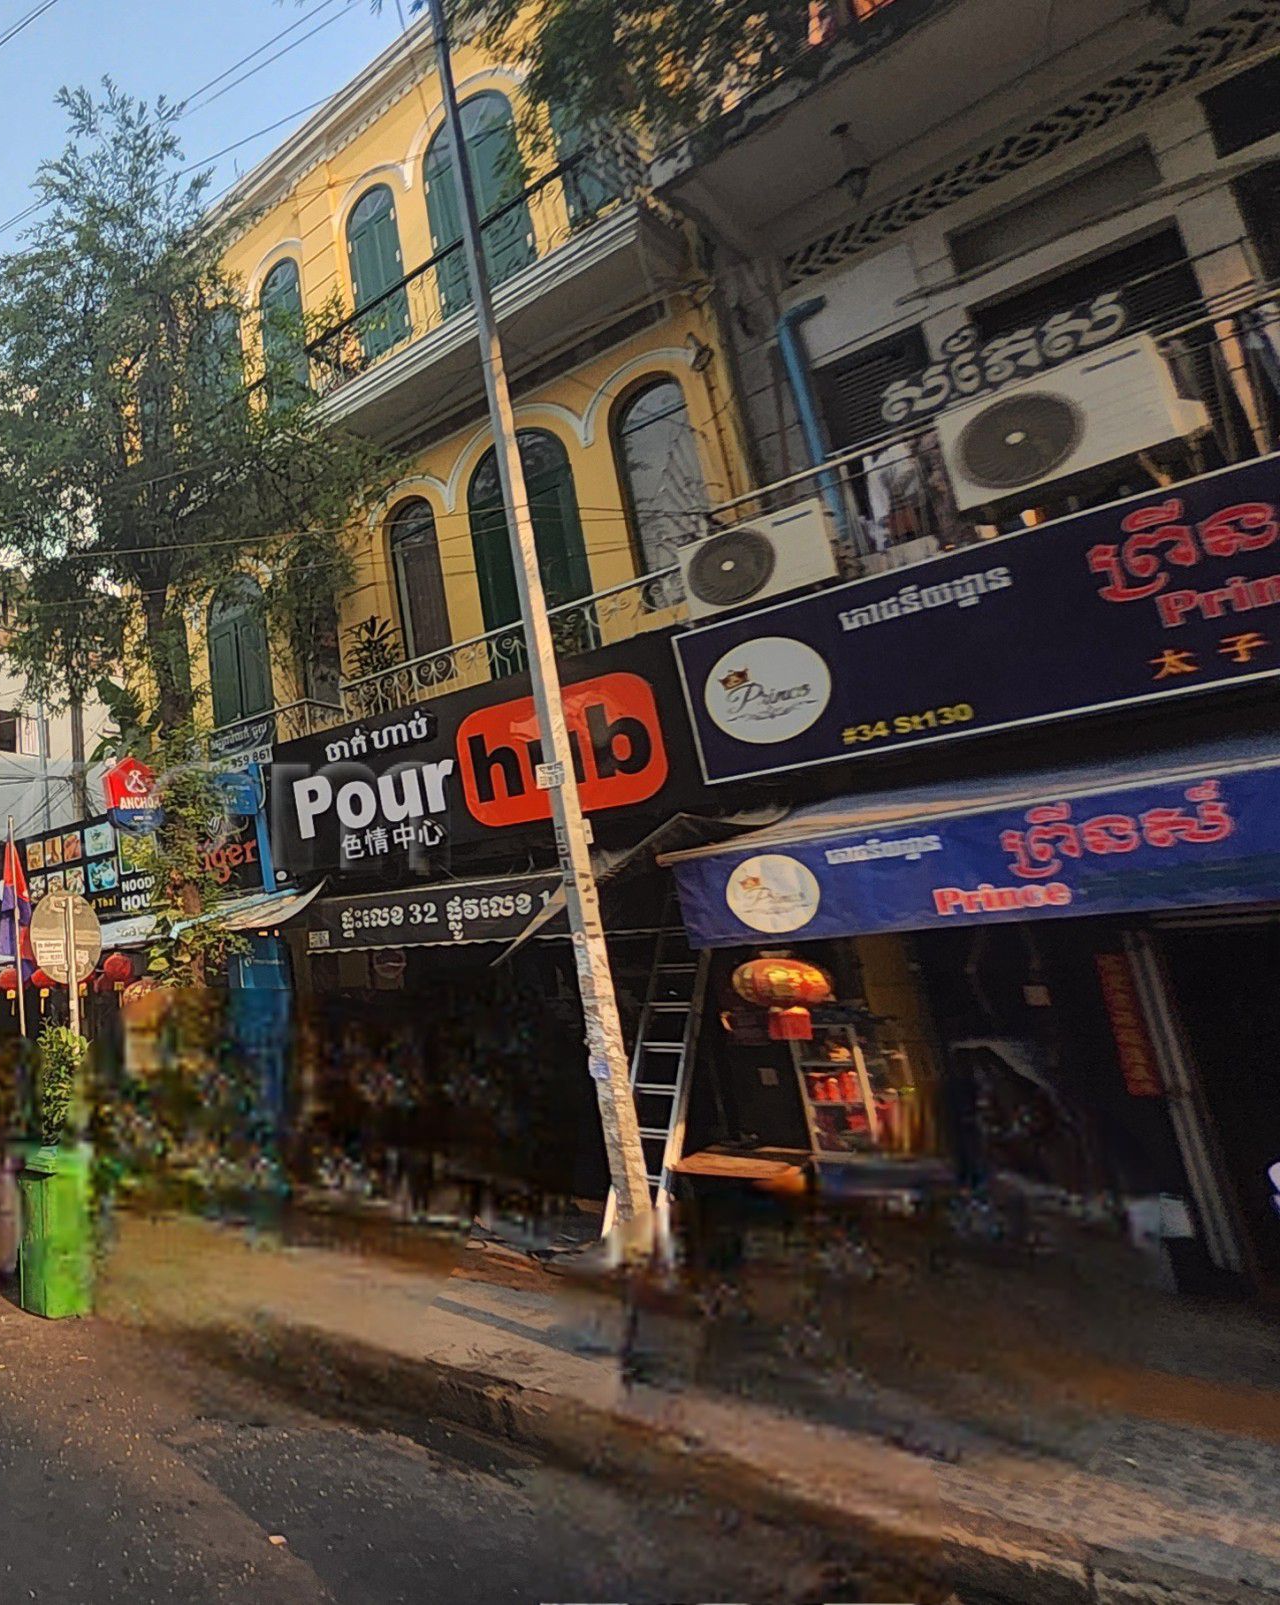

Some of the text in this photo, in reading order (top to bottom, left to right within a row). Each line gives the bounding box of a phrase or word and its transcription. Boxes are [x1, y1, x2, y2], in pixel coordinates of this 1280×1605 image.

[291, 757, 455, 840] Pour
[194, 838, 258, 884] iger
[341, 818, 444, 861] 色情中心
[408, 901, 439, 925] 32
[933, 881, 1072, 918] Prince
